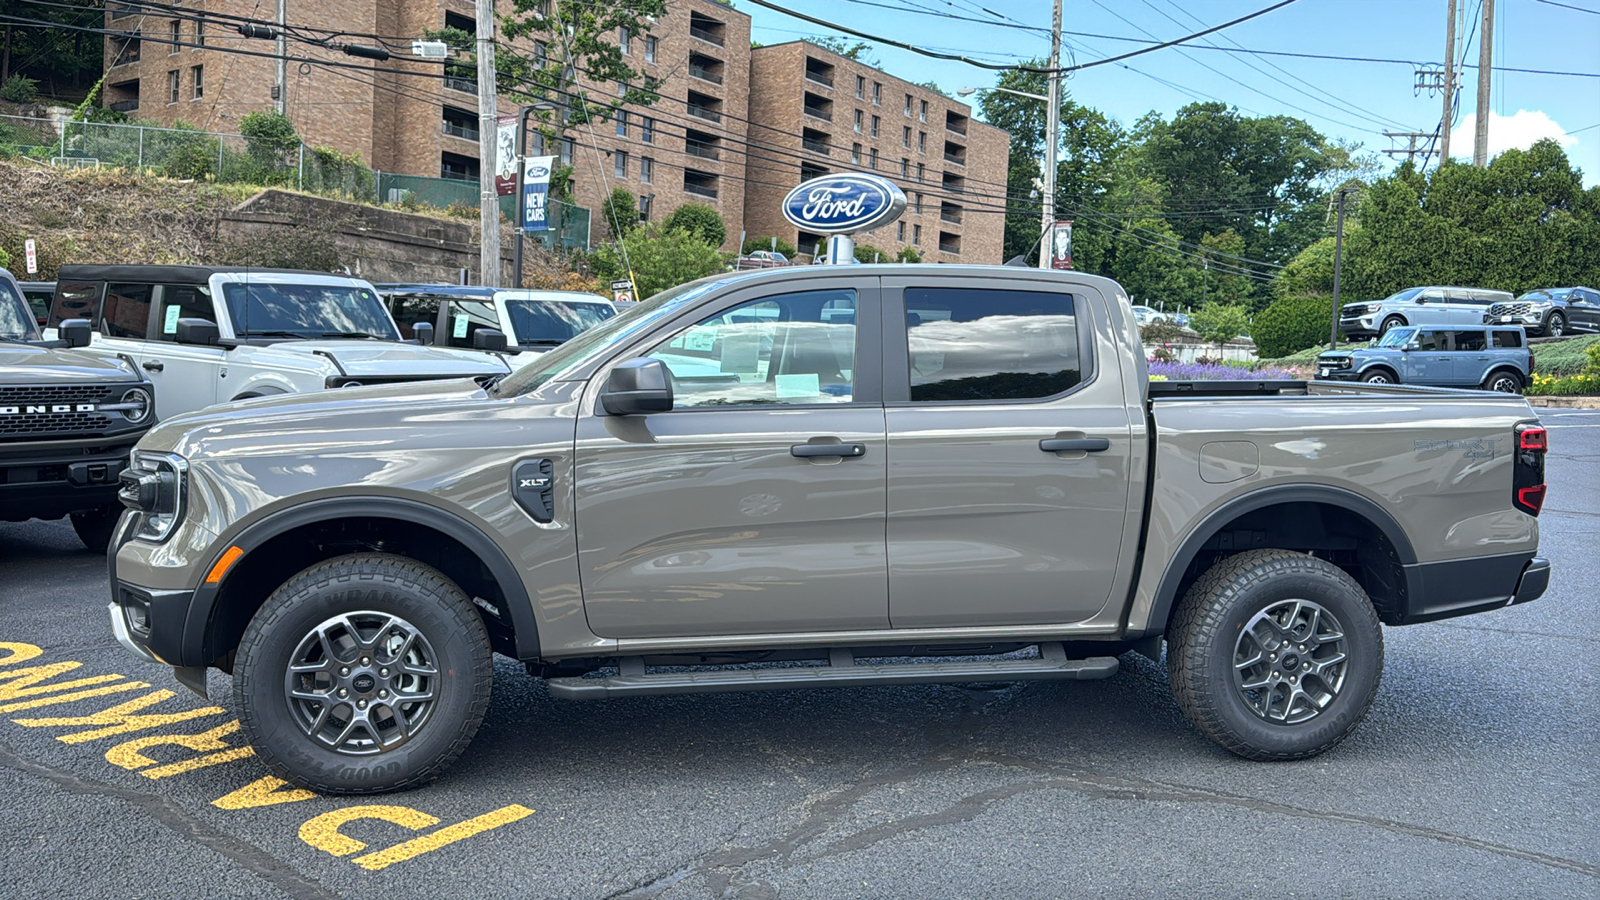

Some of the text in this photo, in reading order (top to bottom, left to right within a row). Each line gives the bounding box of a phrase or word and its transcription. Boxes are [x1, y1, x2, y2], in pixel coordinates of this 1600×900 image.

[526, 193, 545, 208] NEW
[802, 186, 867, 220] Ford
[526, 208, 545, 222] CARS
[1414, 439, 1495, 452] SPORT
[520, 478, 549, 487] XLT
